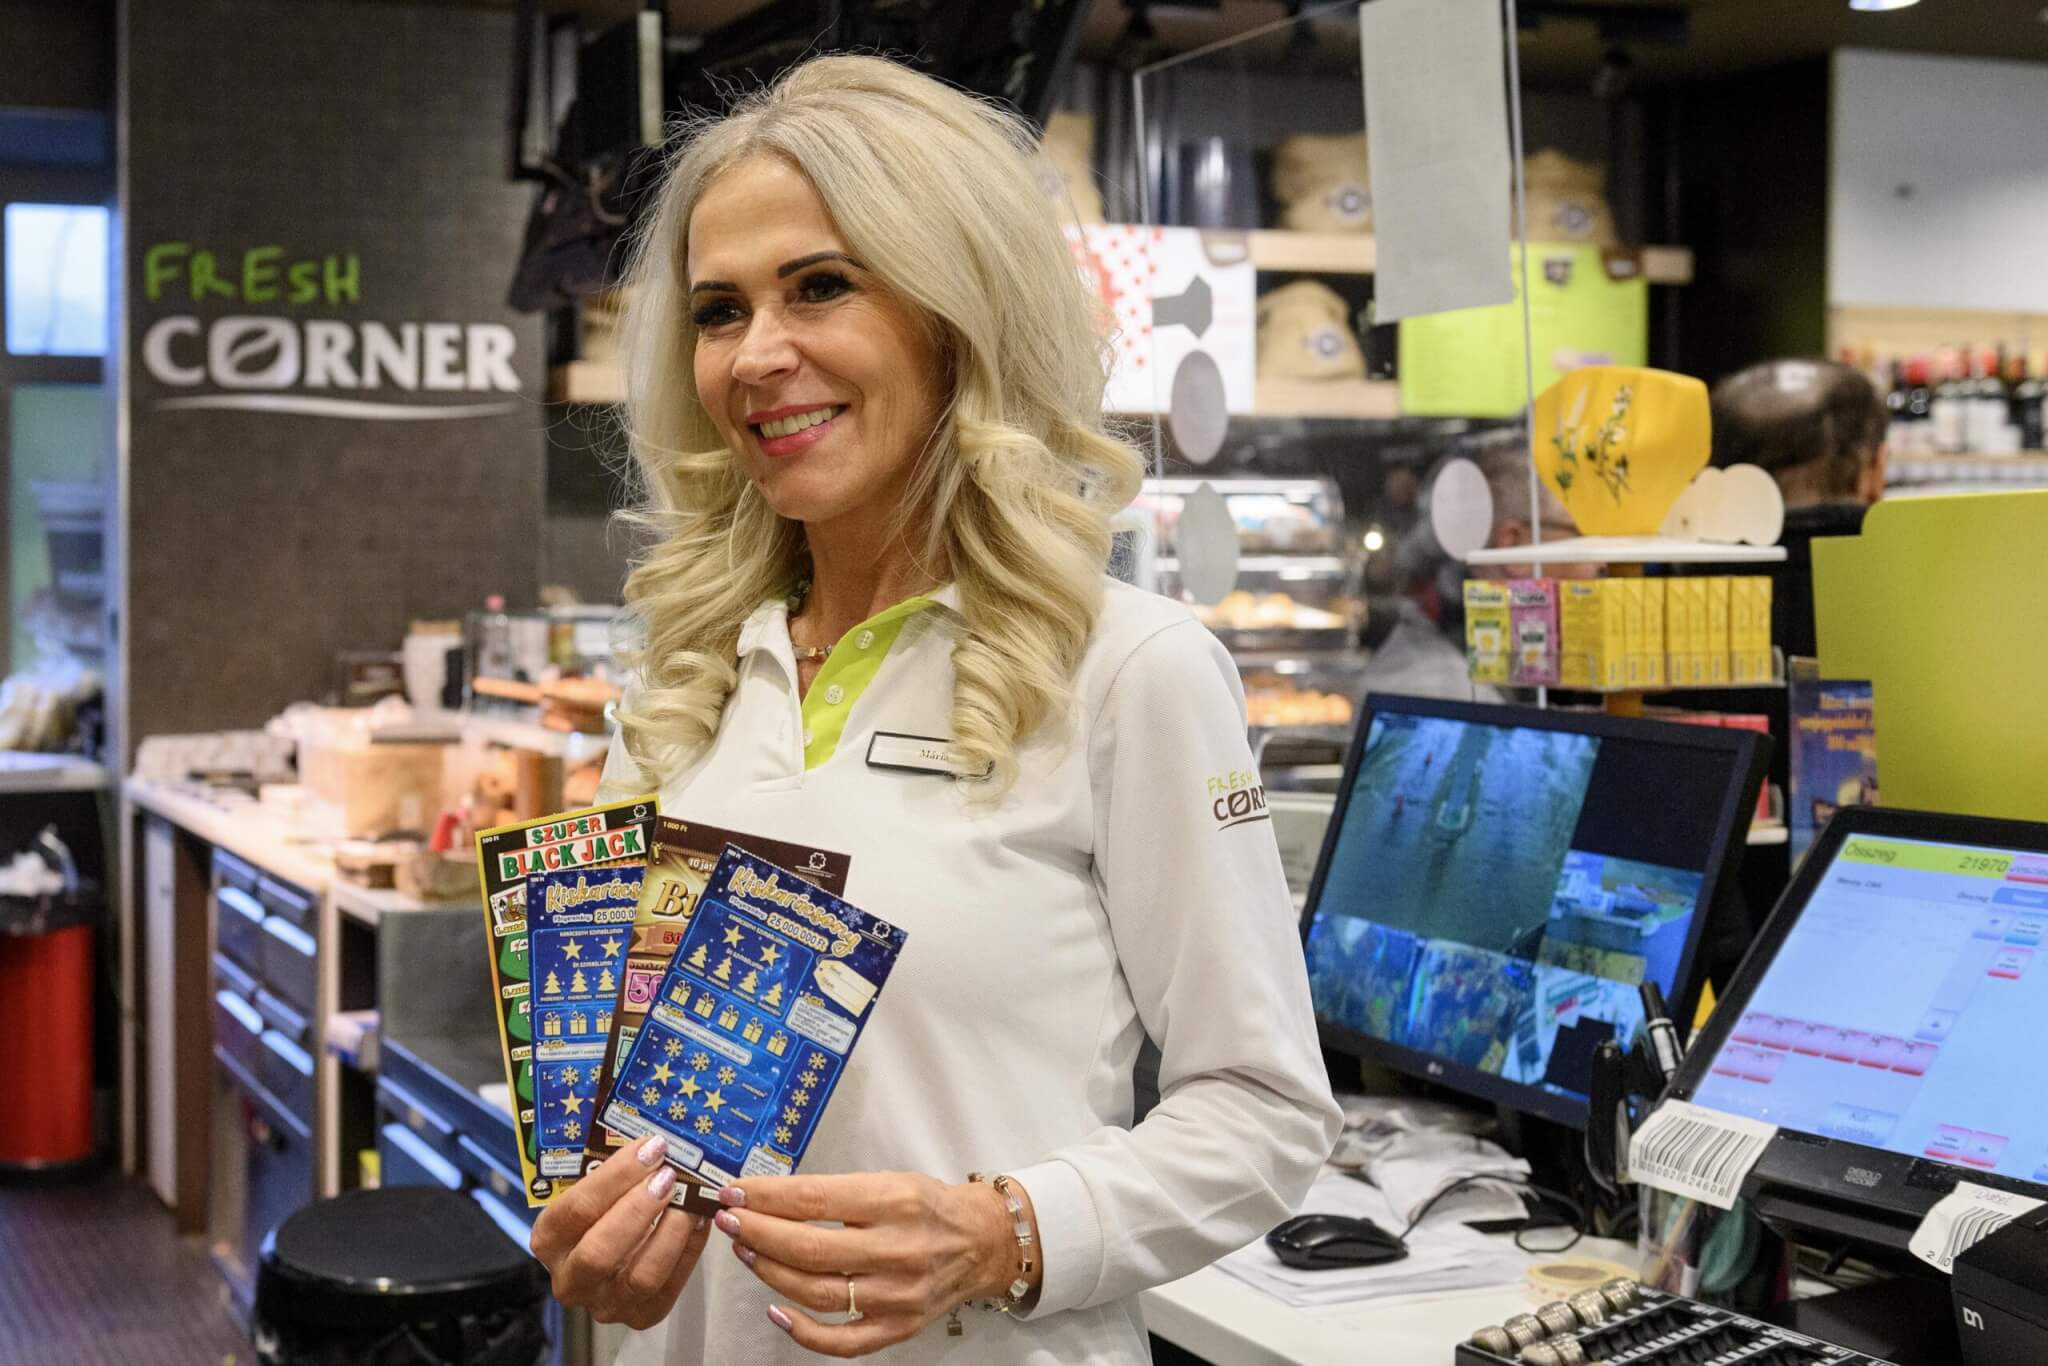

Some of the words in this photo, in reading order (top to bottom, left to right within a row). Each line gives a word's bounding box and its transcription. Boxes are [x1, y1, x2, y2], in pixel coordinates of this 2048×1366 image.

[143, 243, 362, 305] FRESH
[142, 315, 521, 392] CORNER
[503, 843, 578, 880] BLACK
[580, 829, 641, 863] JACK
[531, 816, 602, 844] SZUPER
[1958, 855, 2009, 873] 21970
[728, 866, 861, 956] Kiskarácsony
